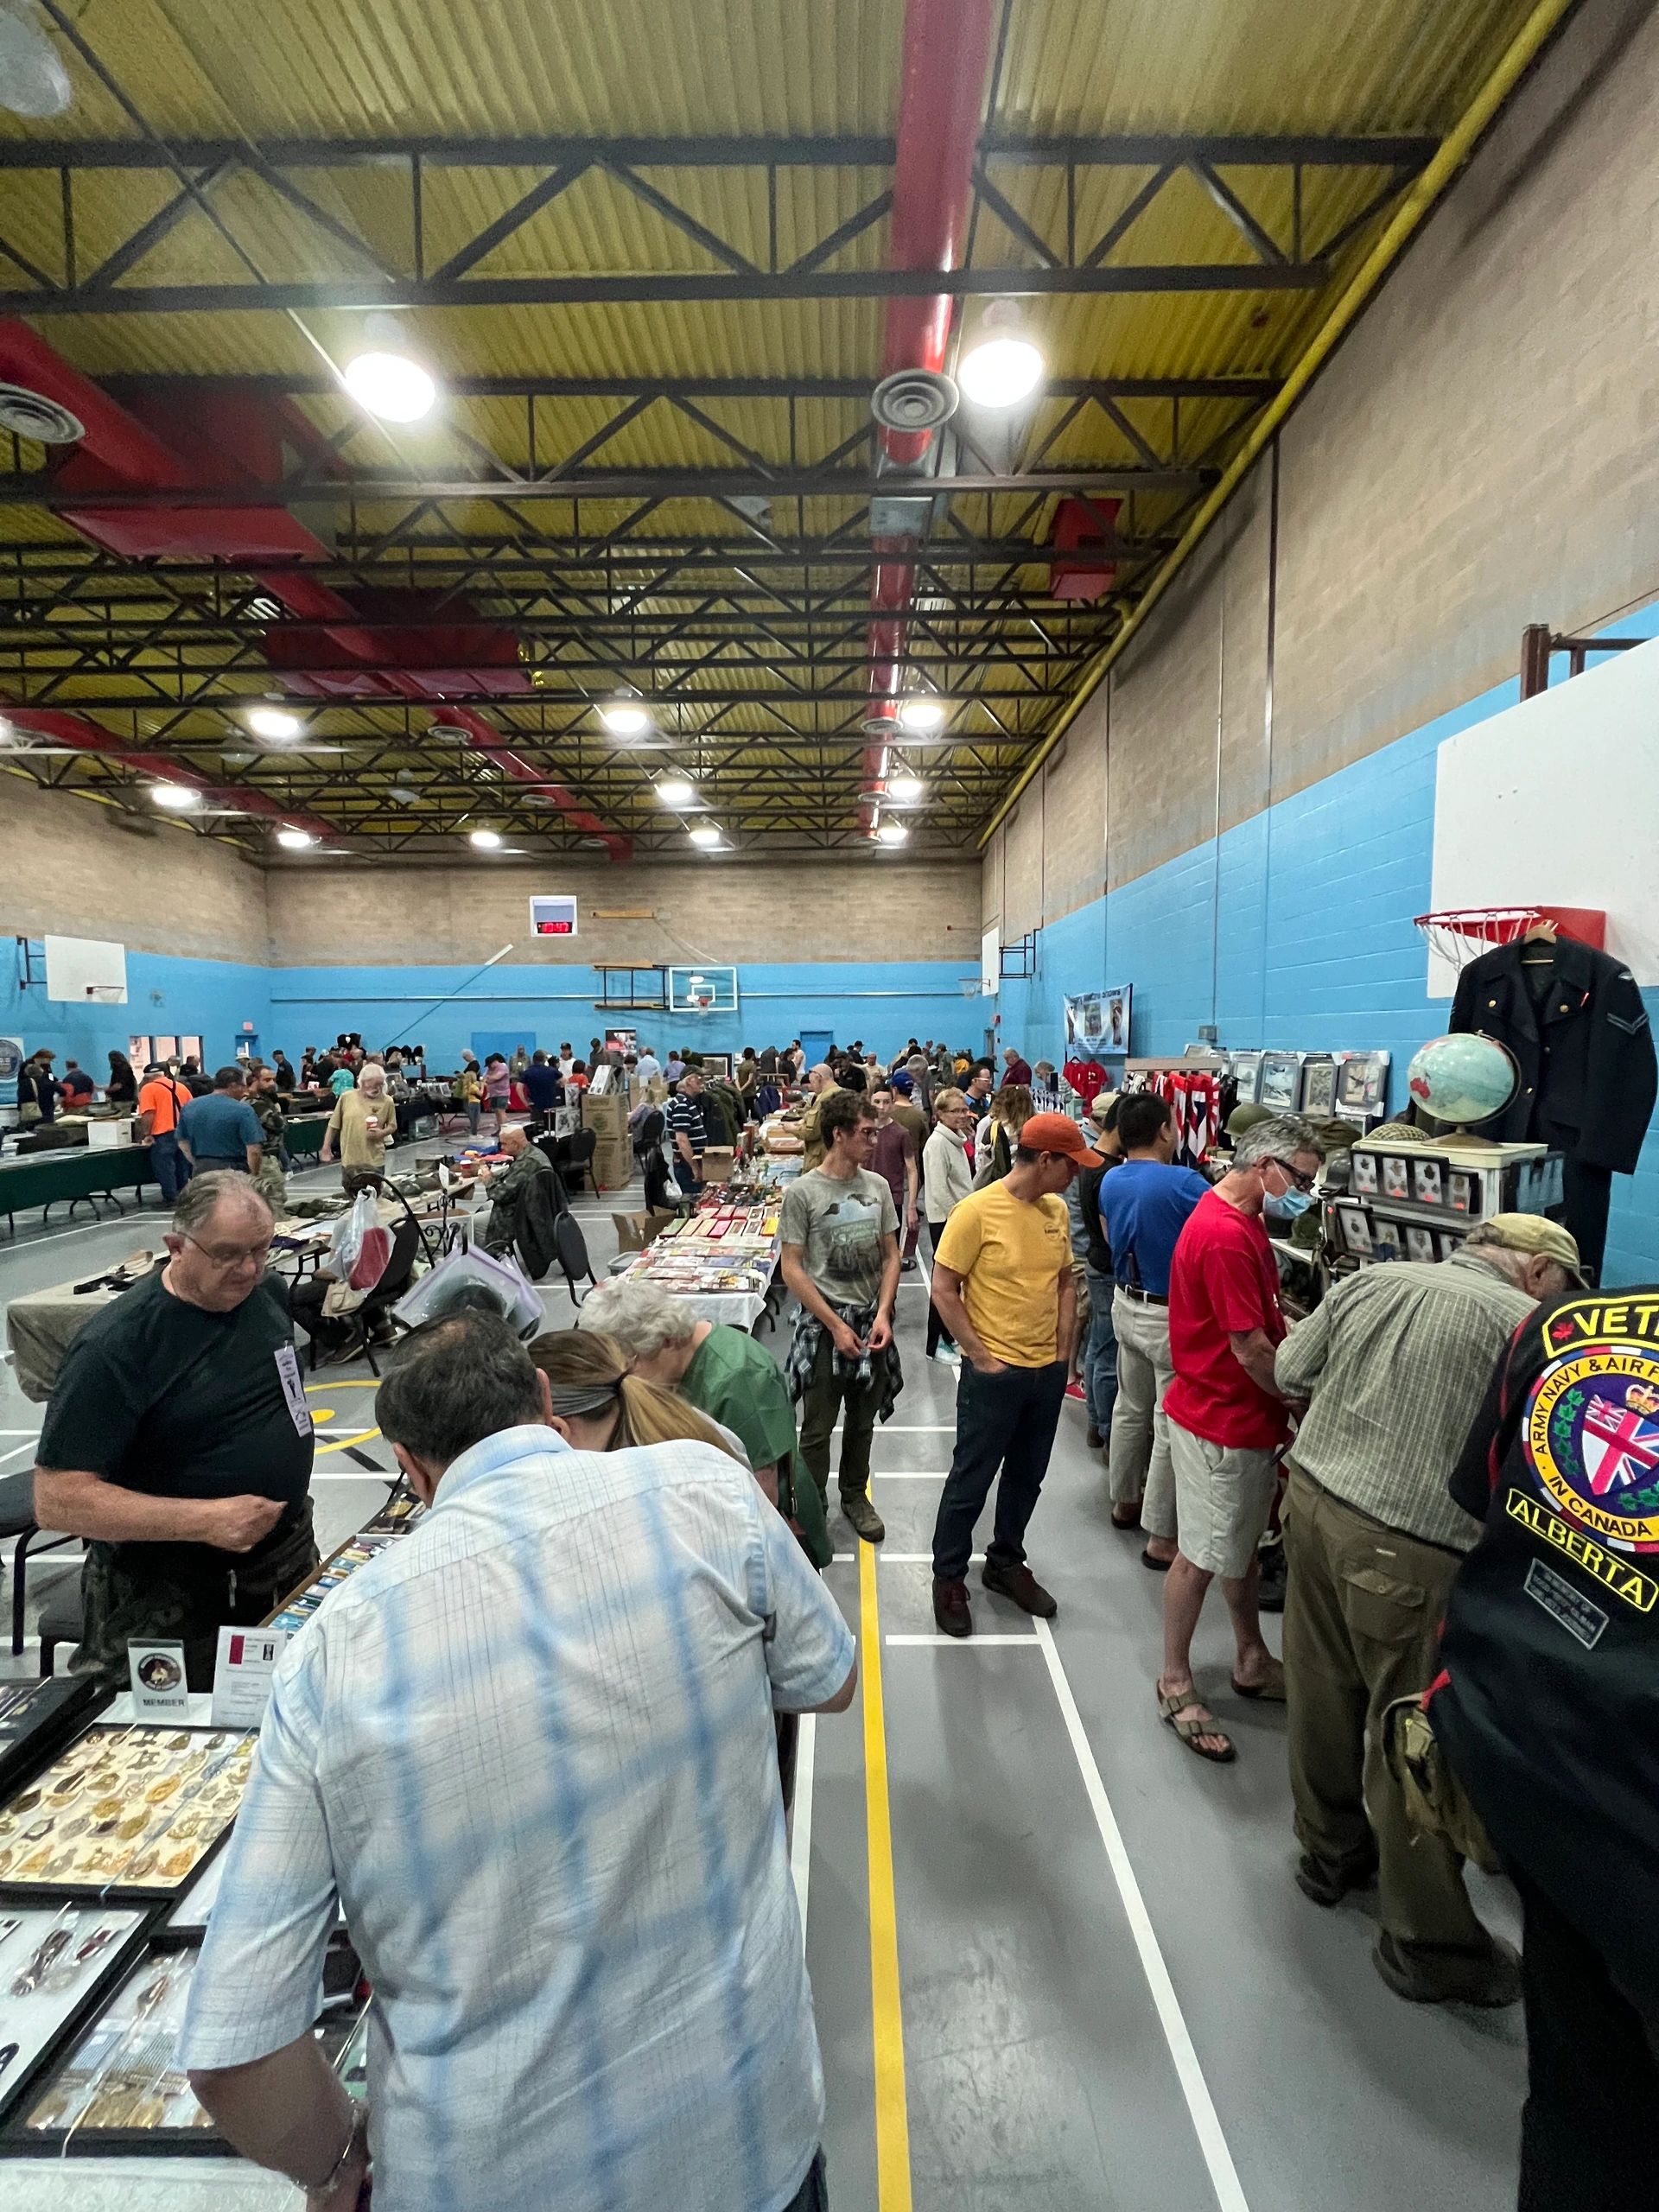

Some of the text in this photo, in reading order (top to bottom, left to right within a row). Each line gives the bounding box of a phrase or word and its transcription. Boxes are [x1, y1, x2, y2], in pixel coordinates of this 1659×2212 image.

[1573, 1306, 1659, 1336] VET
[1533, 1402, 1549, 1455] ARMY
[1542, 1363, 1580, 1402] NAVY
[1605, 1357, 1644, 1373] AIR
[1548, 1476, 1652, 1537] IN CANADA
[1512, 1499, 1643, 1605] ALBERTA
